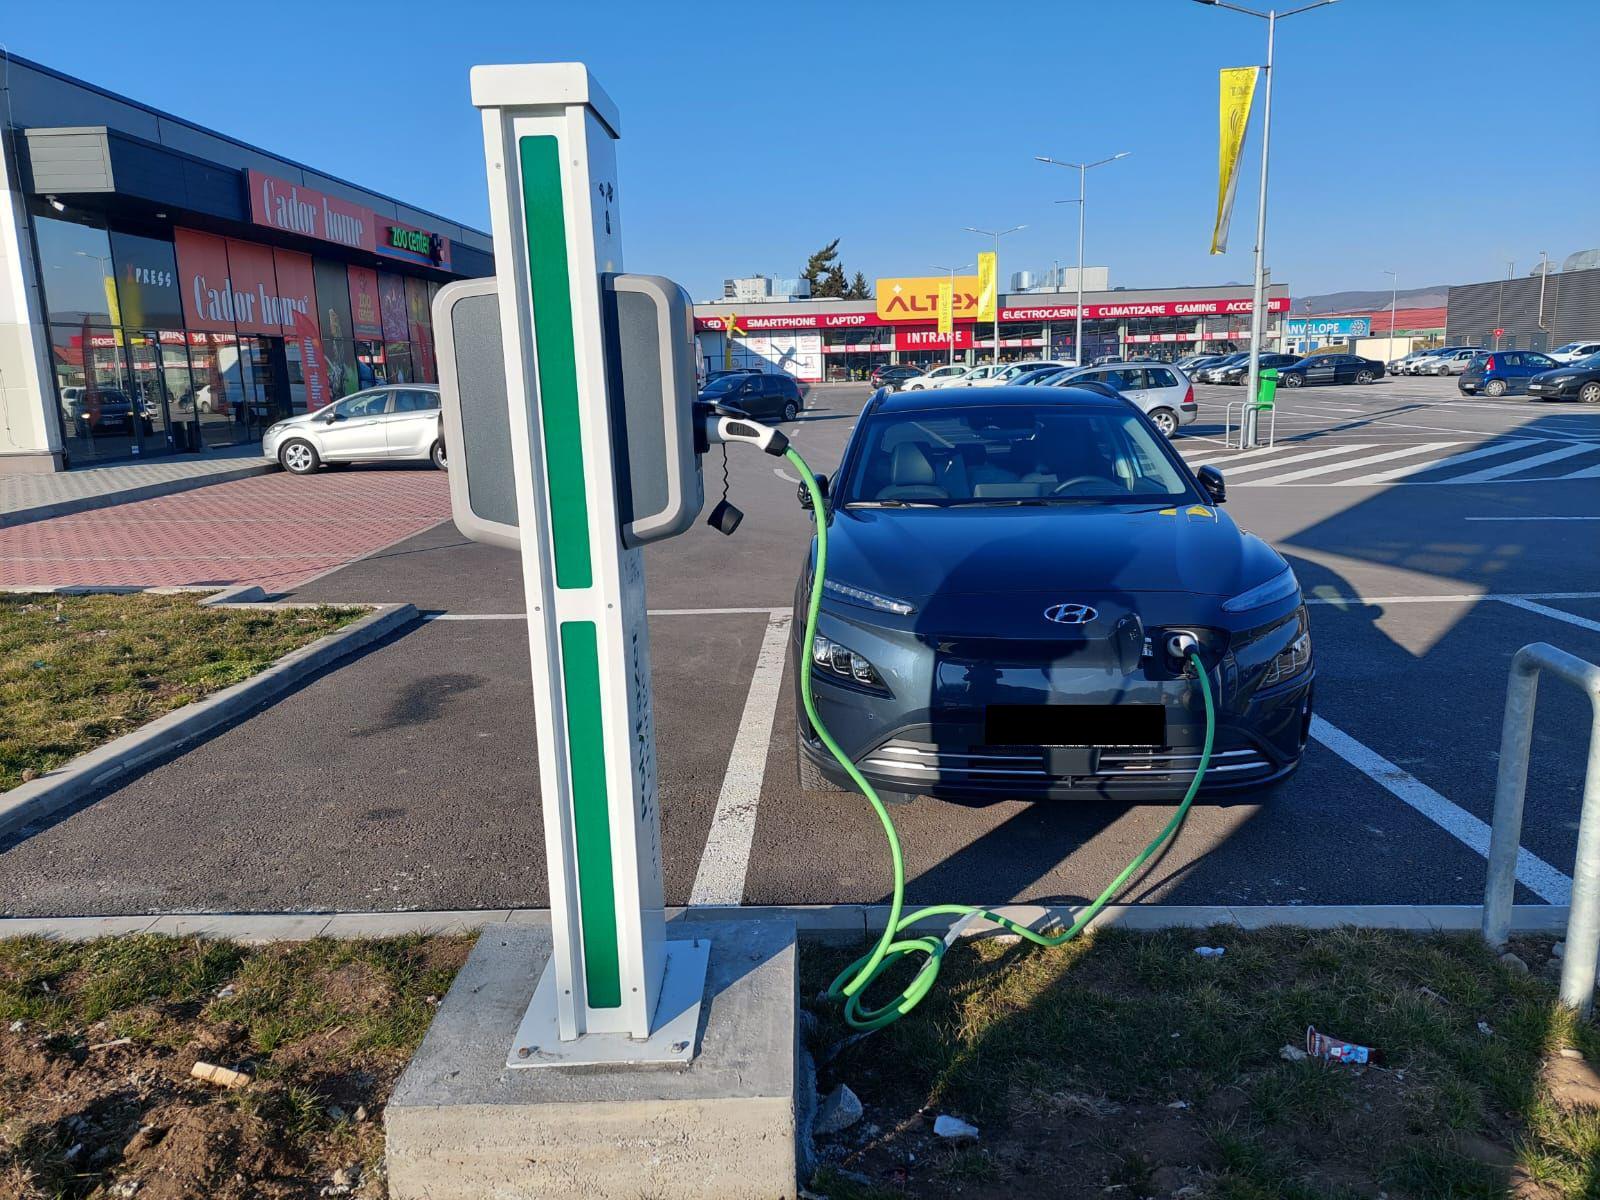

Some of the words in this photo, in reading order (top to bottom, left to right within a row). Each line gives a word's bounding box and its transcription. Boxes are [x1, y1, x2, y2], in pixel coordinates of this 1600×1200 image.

[262, 176, 318, 235] Cador
[322, 197, 364, 246] home
[193, 272, 255, 323] Cador
[1002, 308, 1089, 319] ELECTROCASNIE
[1098, 305, 1165, 316] CLIMATIZARE
[1175, 303, 1217, 313] GAMING
[1226, 301, 1280, 311] ACCERII
[702, 320, 721, 329] LED
[747, 317, 816, 328] SMARTPHONE
[826, 315, 865, 325] LAPTOP
[907, 331, 962, 344] INTRARE
